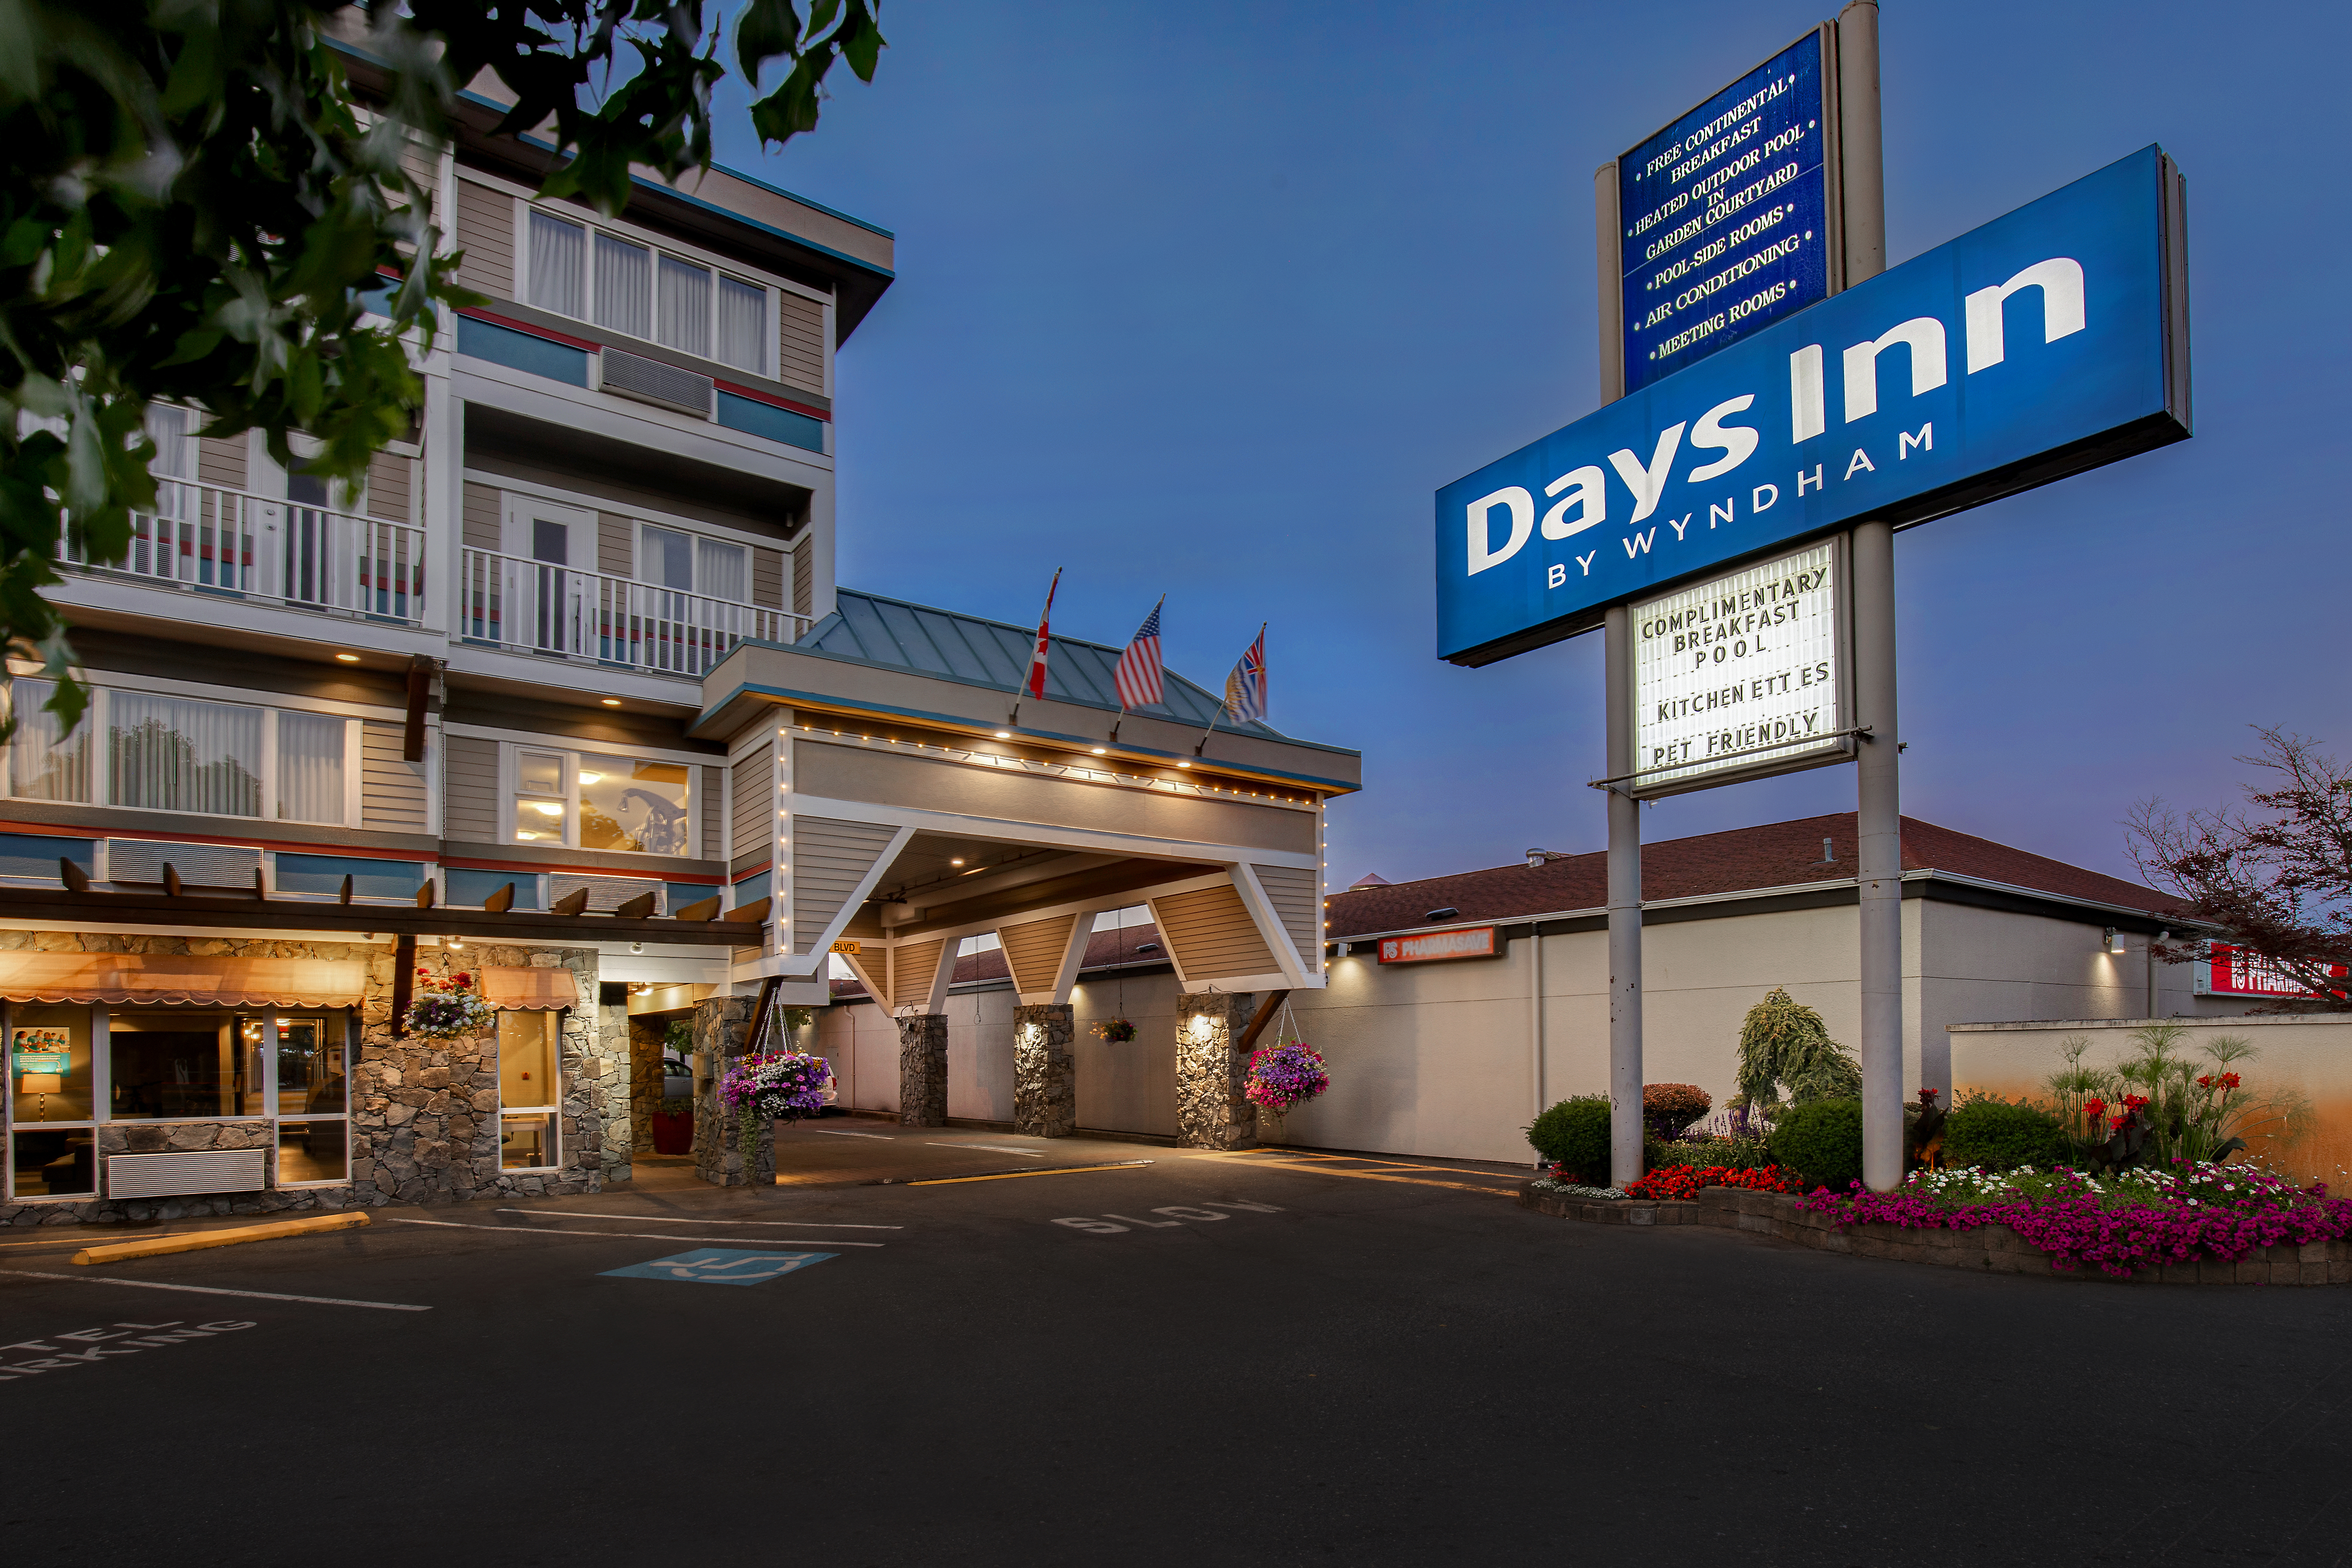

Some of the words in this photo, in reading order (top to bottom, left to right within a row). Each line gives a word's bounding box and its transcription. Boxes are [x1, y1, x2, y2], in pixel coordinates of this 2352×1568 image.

[1646, 143, 1681, 178] FREE
[1685, 78, 1788, 152] CONTINENTAL
[1671, 116, 1762, 184] BREAKFAST
[1635, 192, 1688, 236] HEATED
[1692, 150, 1760, 200] OUTDOOR
[1764, 124, 1805, 165] POOL
[1646, 216, 1702, 260] GARDEN
[1705, 162, 1798, 225] COURTYARD
[1707, 187, 1725, 207] IN
[1645, 303, 1672, 328] AIR
[1676, 234, 1801, 310] CONDITIONING
[1655, 238, 1726, 289] POOL-SIDE
[1729, 207, 1784, 246] ROOMS
[1658, 313, 1725, 359] MEETING
[1729, 283, 1786, 324] ROOMS
[1467, 394, 1759, 577] Days
[1790, 257, 2086, 445] Inn
[1549, 550, 1596, 589] BY
[1623, 423, 1932, 559] WYNDHAM
[1642, 567, 1827, 639] COMPLIMENTARY
[1674, 600, 1799, 652] BREAKFAST
[1695, 635, 1766, 668] POOL
[1654, 741, 1691, 764] PET
[1708, 713, 1818, 753] FRIENDLY
[835, 943, 855, 951] BLVD
[1403, 933, 1489, 956] PHARMASAVE
[0, 1321, 185, 1351] TEL
[0, 1320, 257, 1380] RKING
